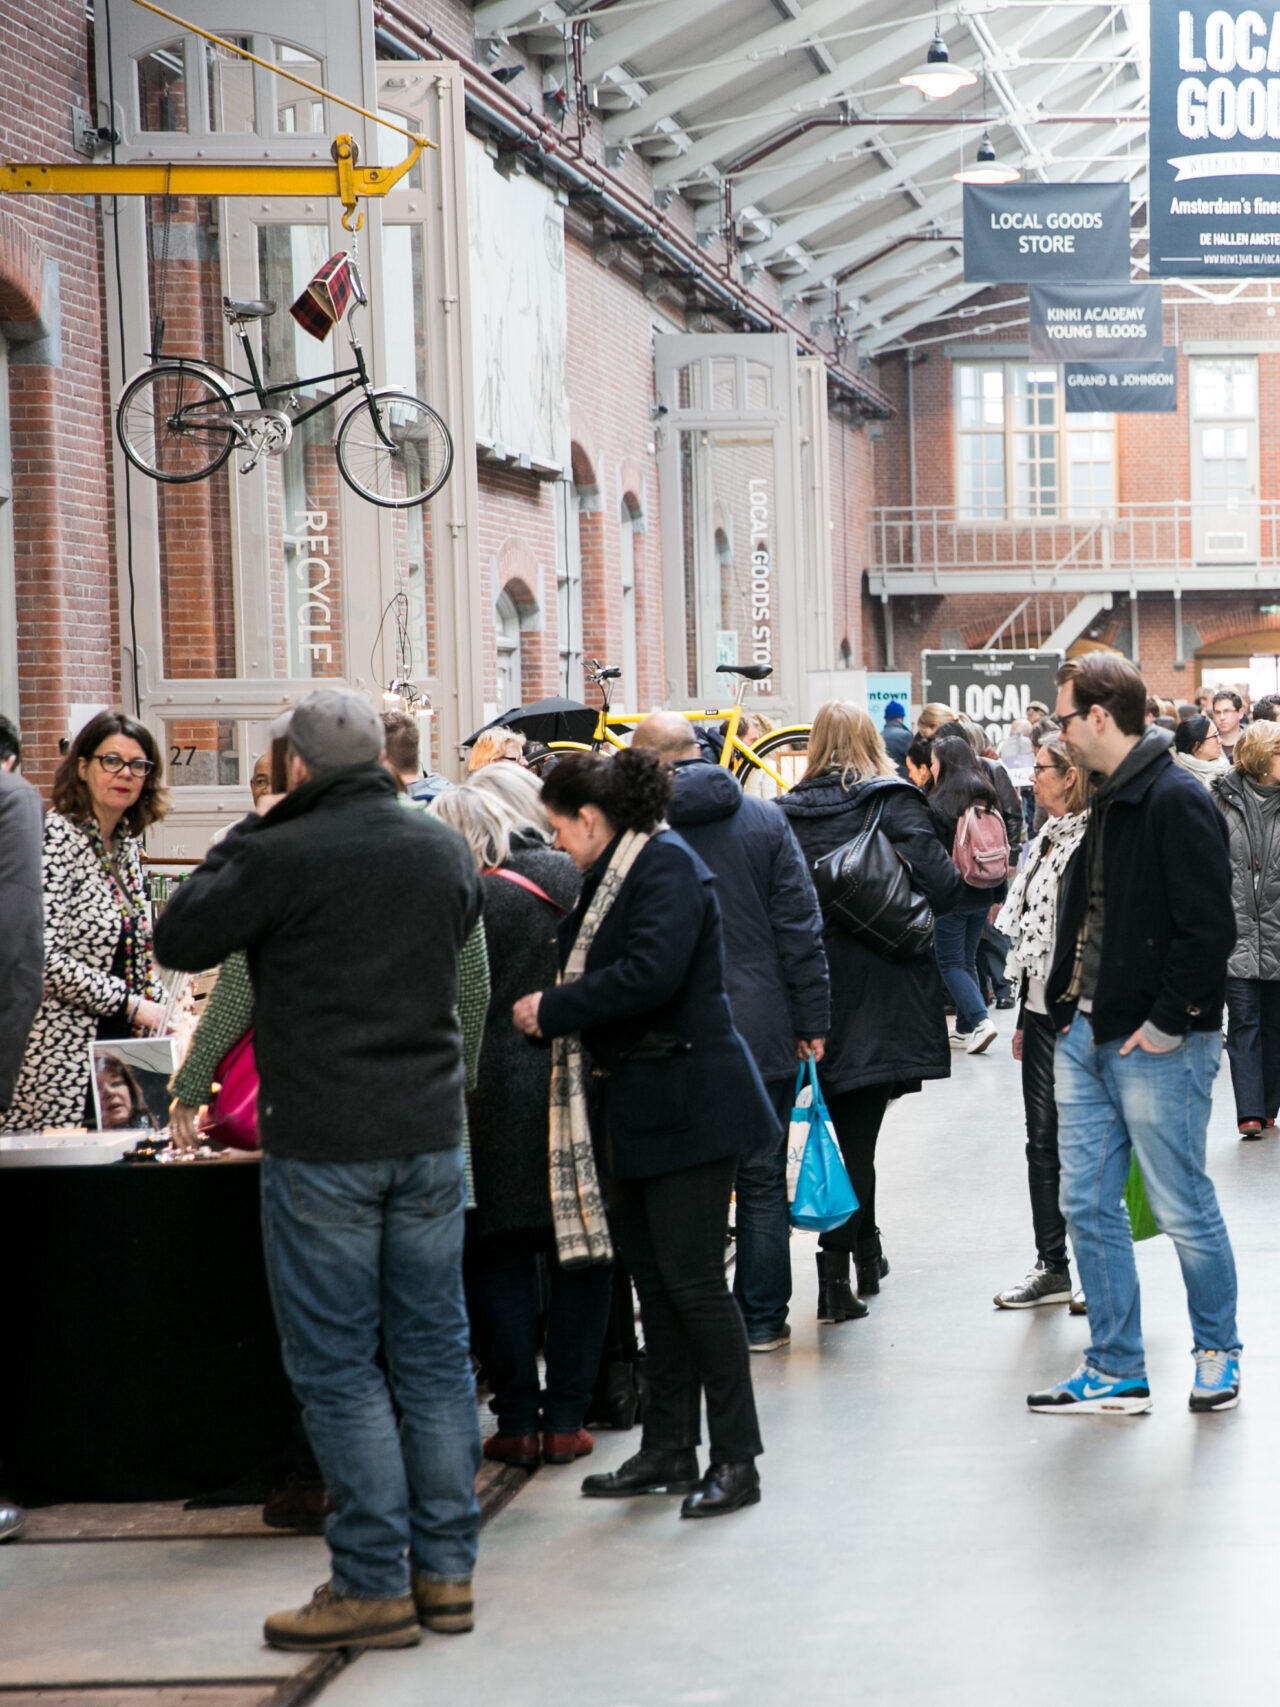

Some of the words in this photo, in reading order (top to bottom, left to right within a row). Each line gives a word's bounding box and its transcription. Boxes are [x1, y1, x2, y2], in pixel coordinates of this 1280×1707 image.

[1189, 156, 1248, 174] WEEKEND
[1170, 197, 1252, 215] Amsterdam's
[990, 212, 1043, 229] LOCAL
[1046, 212, 1103, 229] GOODS
[1018, 235, 1075, 253] STORE
[1199, 232, 1212, 246] DE
[1213, 232, 1249, 246] HALLEN
[1047, 307, 1081, 321] KINKI
[1084, 306, 1146, 321] ACADEMY
[1046, 325, 1093, 339] YOUNG
[1095, 324, 1147, 338] BLOODS
[1067, 373, 1107, 387] GRAND
[1109, 374, 1119, 387] &
[1121, 372, 1174, 386] JOHNSON
[748, 479, 768, 546] LOCAL
[294, 510, 332, 664] RECYCLE
[751, 550, 770, 621] GOODS
[867, 691, 908, 700] ntown
[170, 746, 197, 766] 27
